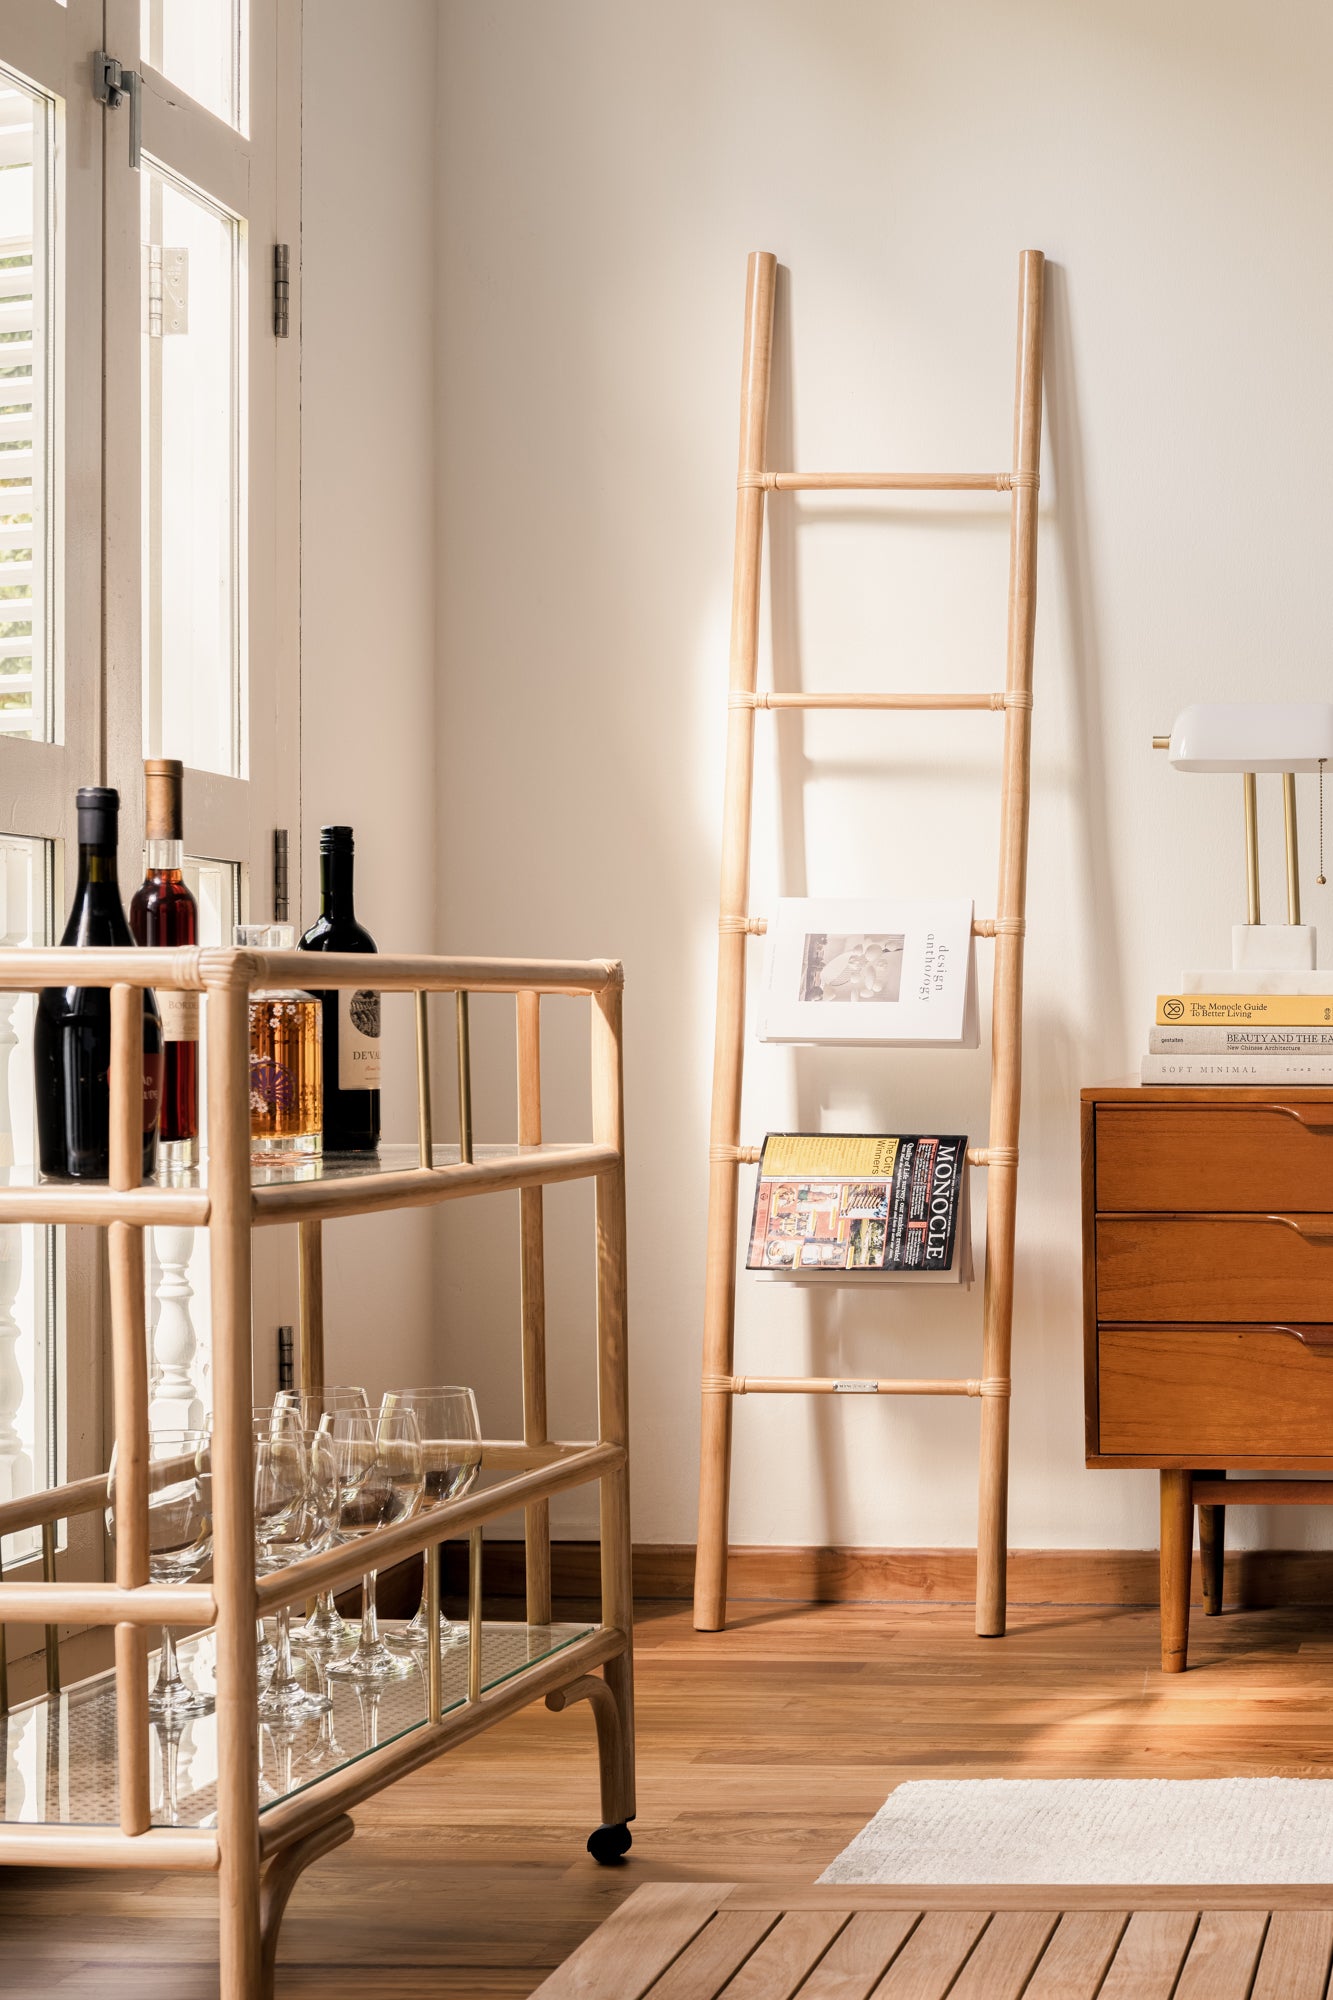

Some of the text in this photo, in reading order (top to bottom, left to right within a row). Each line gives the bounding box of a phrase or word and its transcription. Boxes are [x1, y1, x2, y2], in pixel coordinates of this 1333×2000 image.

[918, 933, 936, 1001] anthology
[933, 945, 950, 991] design
[1190, 1002, 1268, 1011] The Monocle Guide
[1227, 1010, 1252, 1019] Living
[1226, 1034, 1268, 1043] BEAUTY
[1270, 1034, 1294, 1043] AND
[1296, 1034, 1318, 1043] THE
[1161, 1066, 1258, 1074] SOFT MINIMAL
[871, 1140, 887, 1175] Winners
[881, 1140, 898, 1175] The City
[904, 1142, 914, 1161] Quality
[902, 1168, 910, 1180] Life
[926, 1145, 956, 1260] MONOCLE
[896, 1214, 904, 1238] ranking
[893, 1238, 901, 1262] revealed
